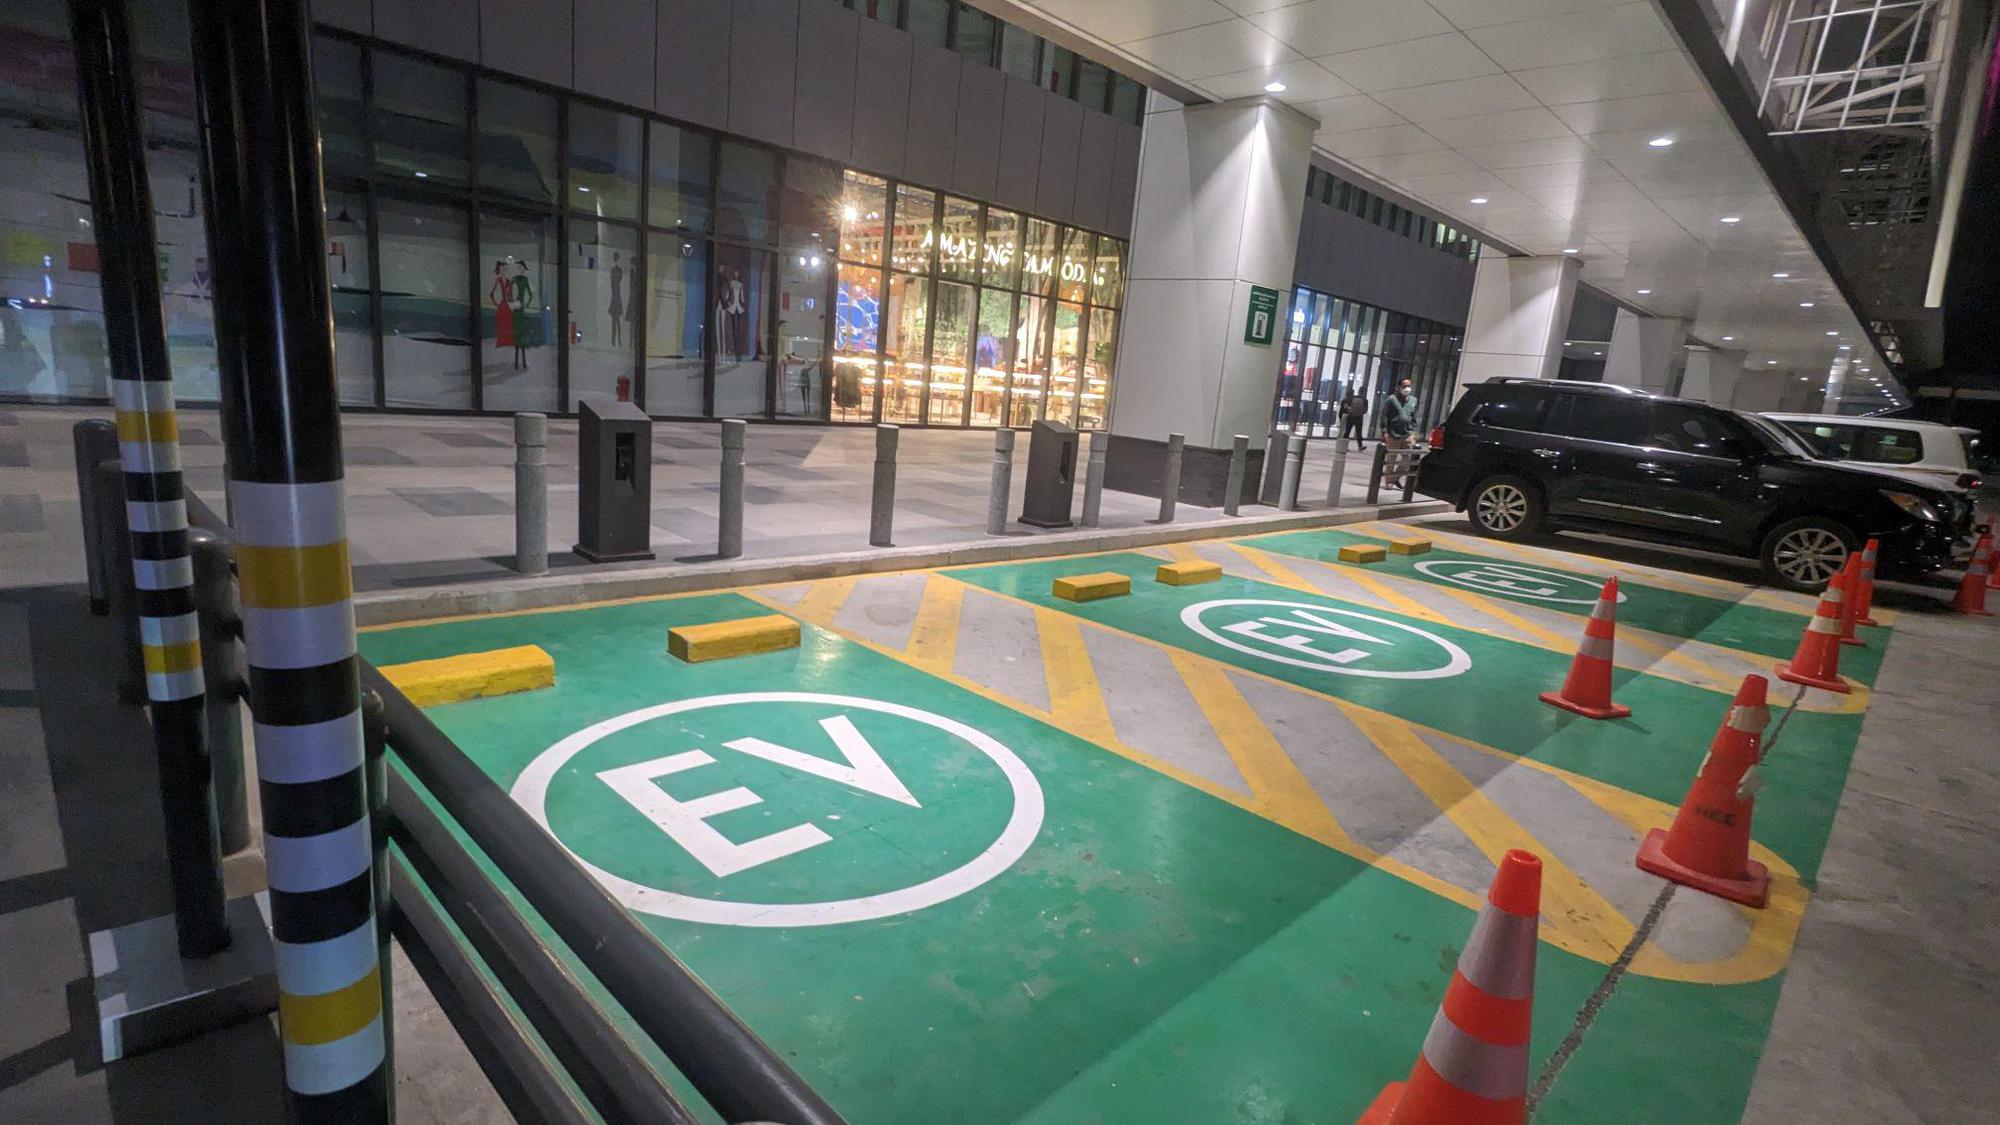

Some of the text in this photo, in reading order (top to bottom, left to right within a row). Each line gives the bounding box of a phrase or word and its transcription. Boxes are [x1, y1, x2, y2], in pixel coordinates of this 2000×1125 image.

[920, 229, 1104, 286] AMAZNG AMOD
[1452, 567, 1566, 596] EV
[1220, 609, 1397, 664] EV
[595, 714, 923, 878] EV
